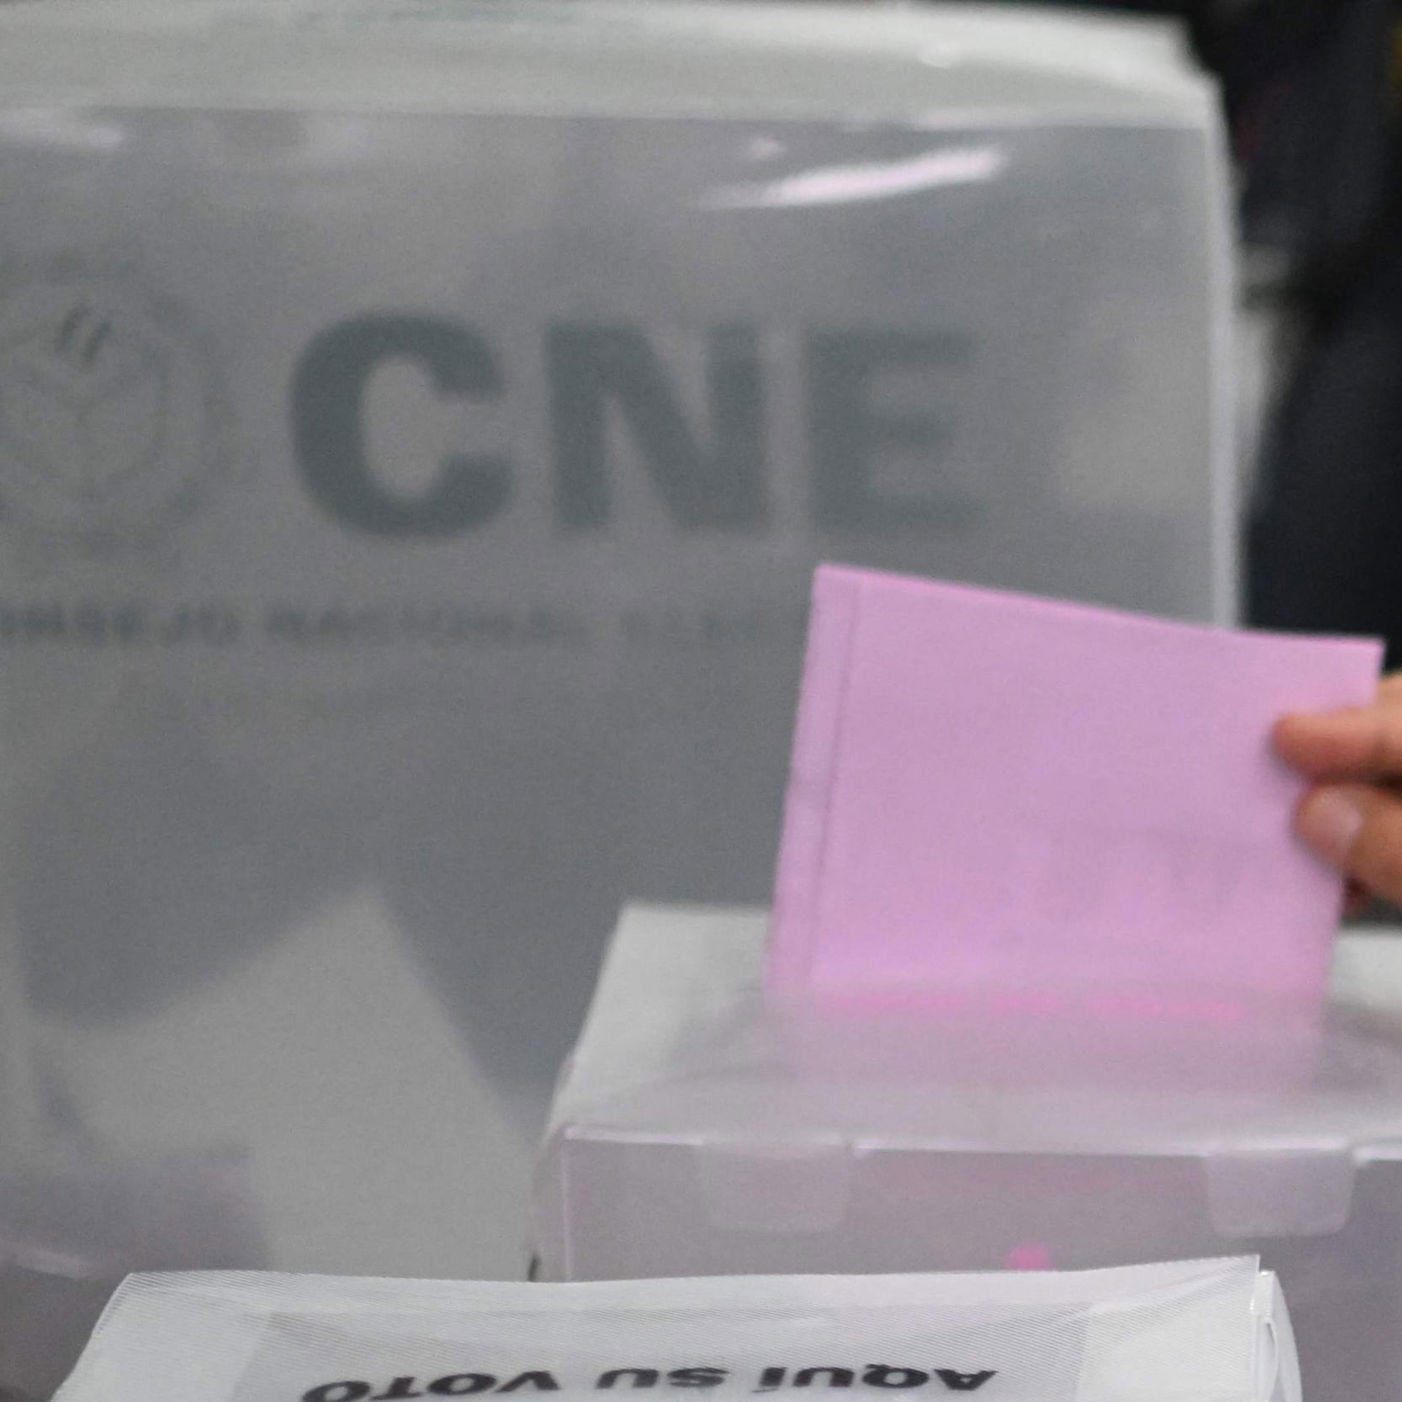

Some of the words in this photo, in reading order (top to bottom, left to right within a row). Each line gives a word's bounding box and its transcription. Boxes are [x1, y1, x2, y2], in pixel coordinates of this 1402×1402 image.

[287, 308, 983, 541] CNE
[595, 1366, 730, 1389] SU
[752, 1363, 999, 1393] AQUÍ
